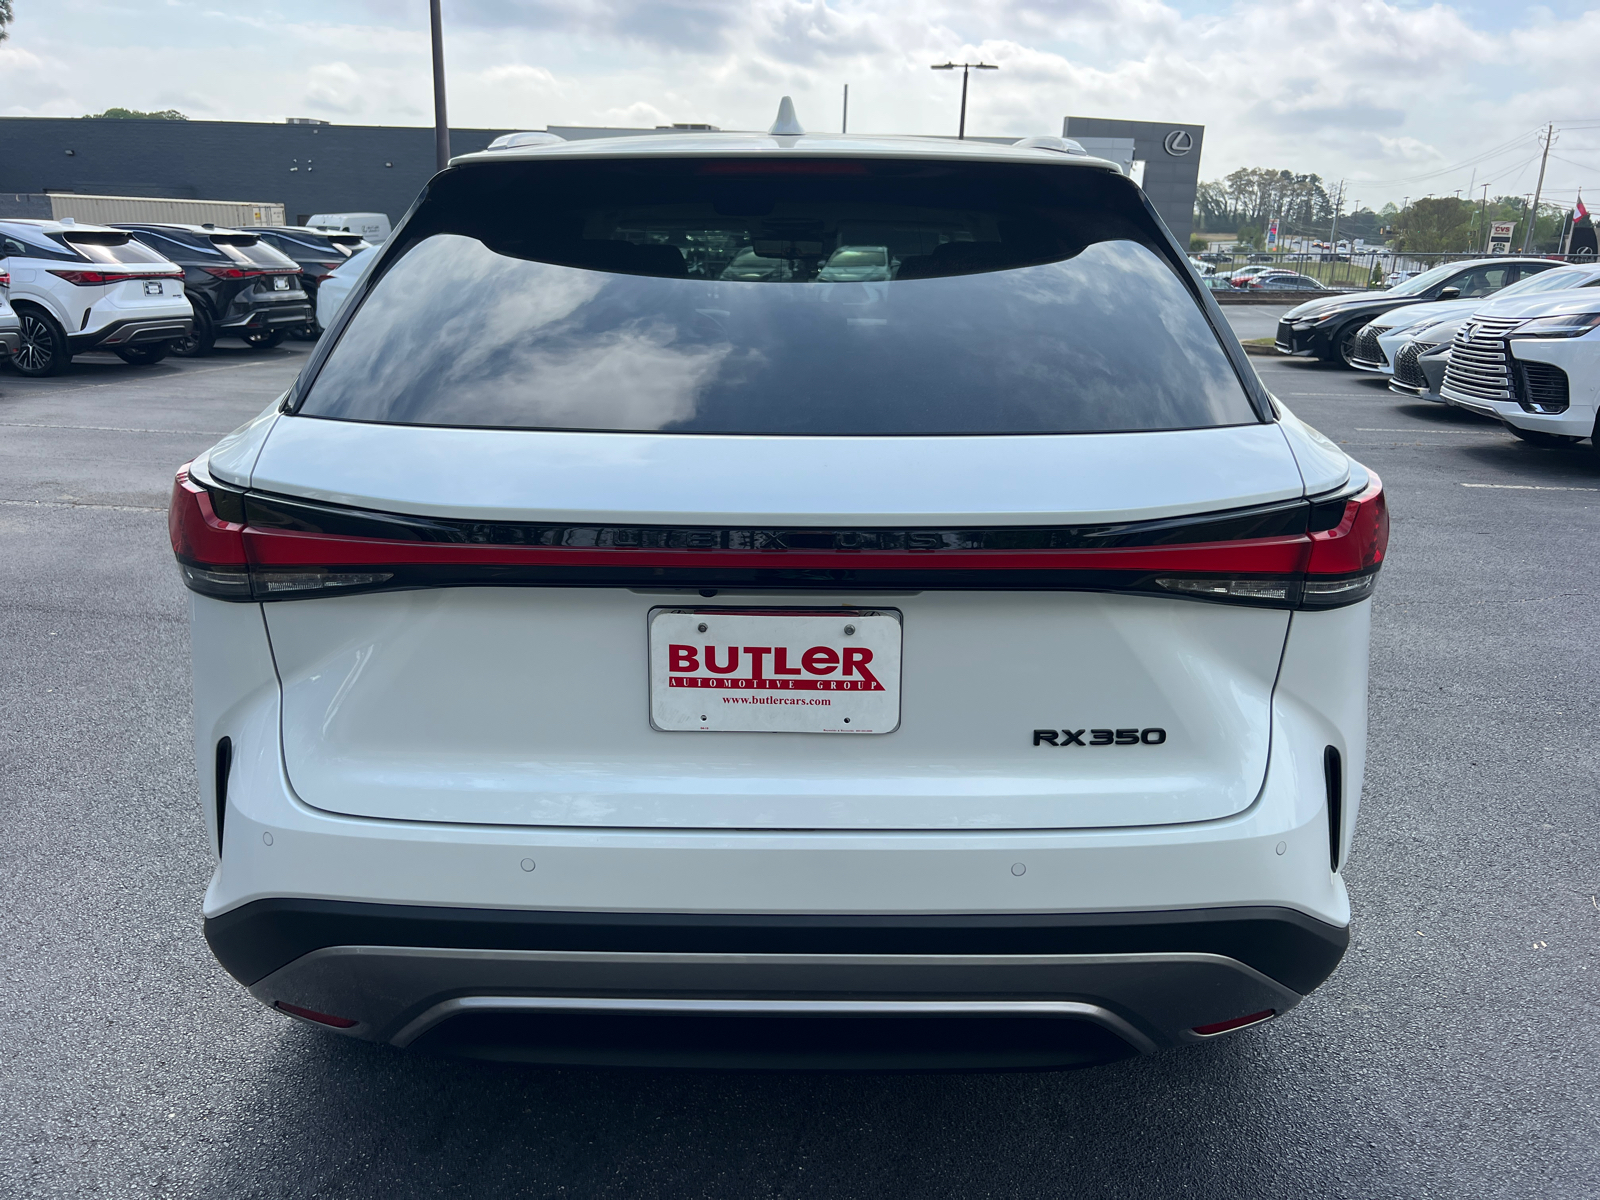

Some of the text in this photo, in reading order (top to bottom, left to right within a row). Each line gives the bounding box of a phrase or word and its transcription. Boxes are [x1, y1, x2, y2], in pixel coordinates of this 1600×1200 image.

[612, 529, 940, 549] LEXUS
[670, 678, 877, 690] AUTOMOTIVE GROUP
[722, 695, 831, 706] www.butlercars.com
